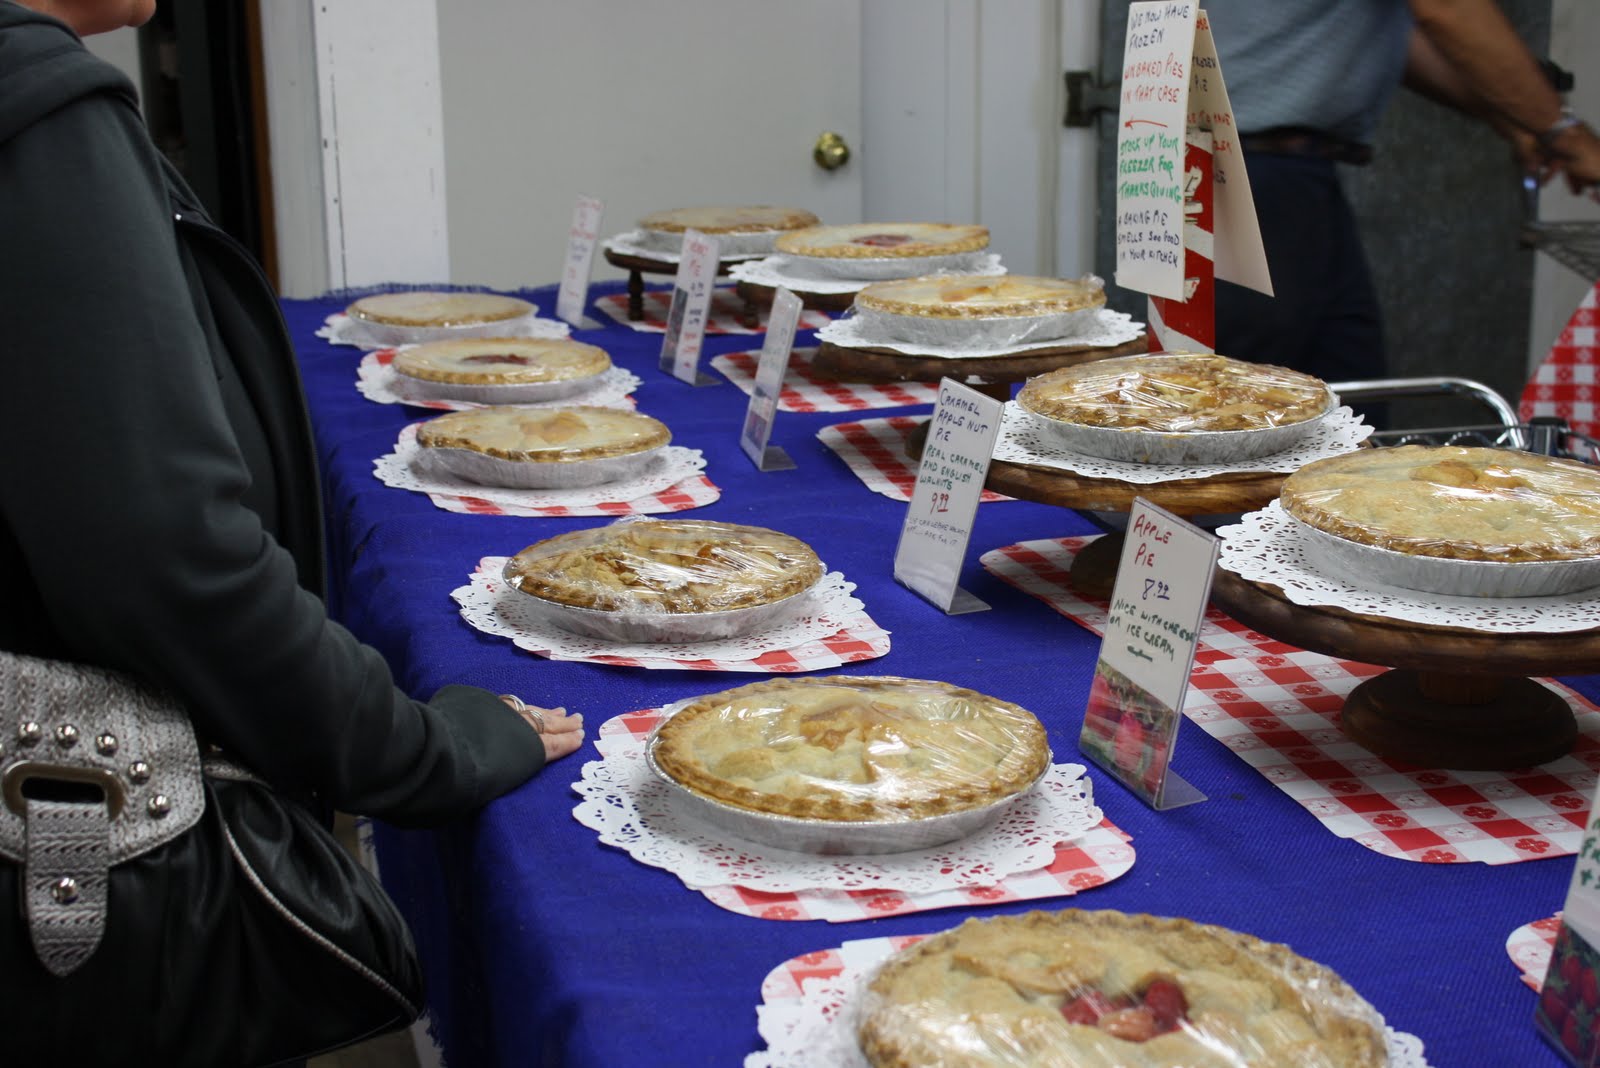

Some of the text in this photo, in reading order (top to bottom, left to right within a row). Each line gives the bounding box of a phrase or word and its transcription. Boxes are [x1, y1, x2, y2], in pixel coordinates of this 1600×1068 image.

[1130, 3, 1189, 31] WE NOW HAVE
[1128, 28, 1165, 53] FROZEN
[1124, 60, 1162, 80] UNBAKED
[1135, 84, 1154, 103] THAT
[1157, 84, 1180, 104] CASE
[1120, 132, 1179, 157] STOCK UP YOUR
[1123, 208, 1151, 226] BAKING
[1117, 231, 1143, 245] SMELLS
[1129, 247, 1146, 261] YOUR
[1148, 248, 1178, 268] KITCHEN
[940, 387, 981, 417] CARAMEL
[935, 427, 952, 442] PIE
[936, 408, 989, 437] APPLE NUT
[921, 459, 972, 484] AND ENGLISH
[925, 444, 984, 475] REAL CARAMEL
[919, 474, 953, 491] WALNUTS
[1133, 513, 1172, 544] APPLE
[1134, 542, 1154, 568] PIE
[1113, 599, 1137, 616] NICE
[1140, 611, 1162, 626] WITH
[1126, 623, 1141, 639] ICE
[1143, 630, 1175, 663] CREAM
